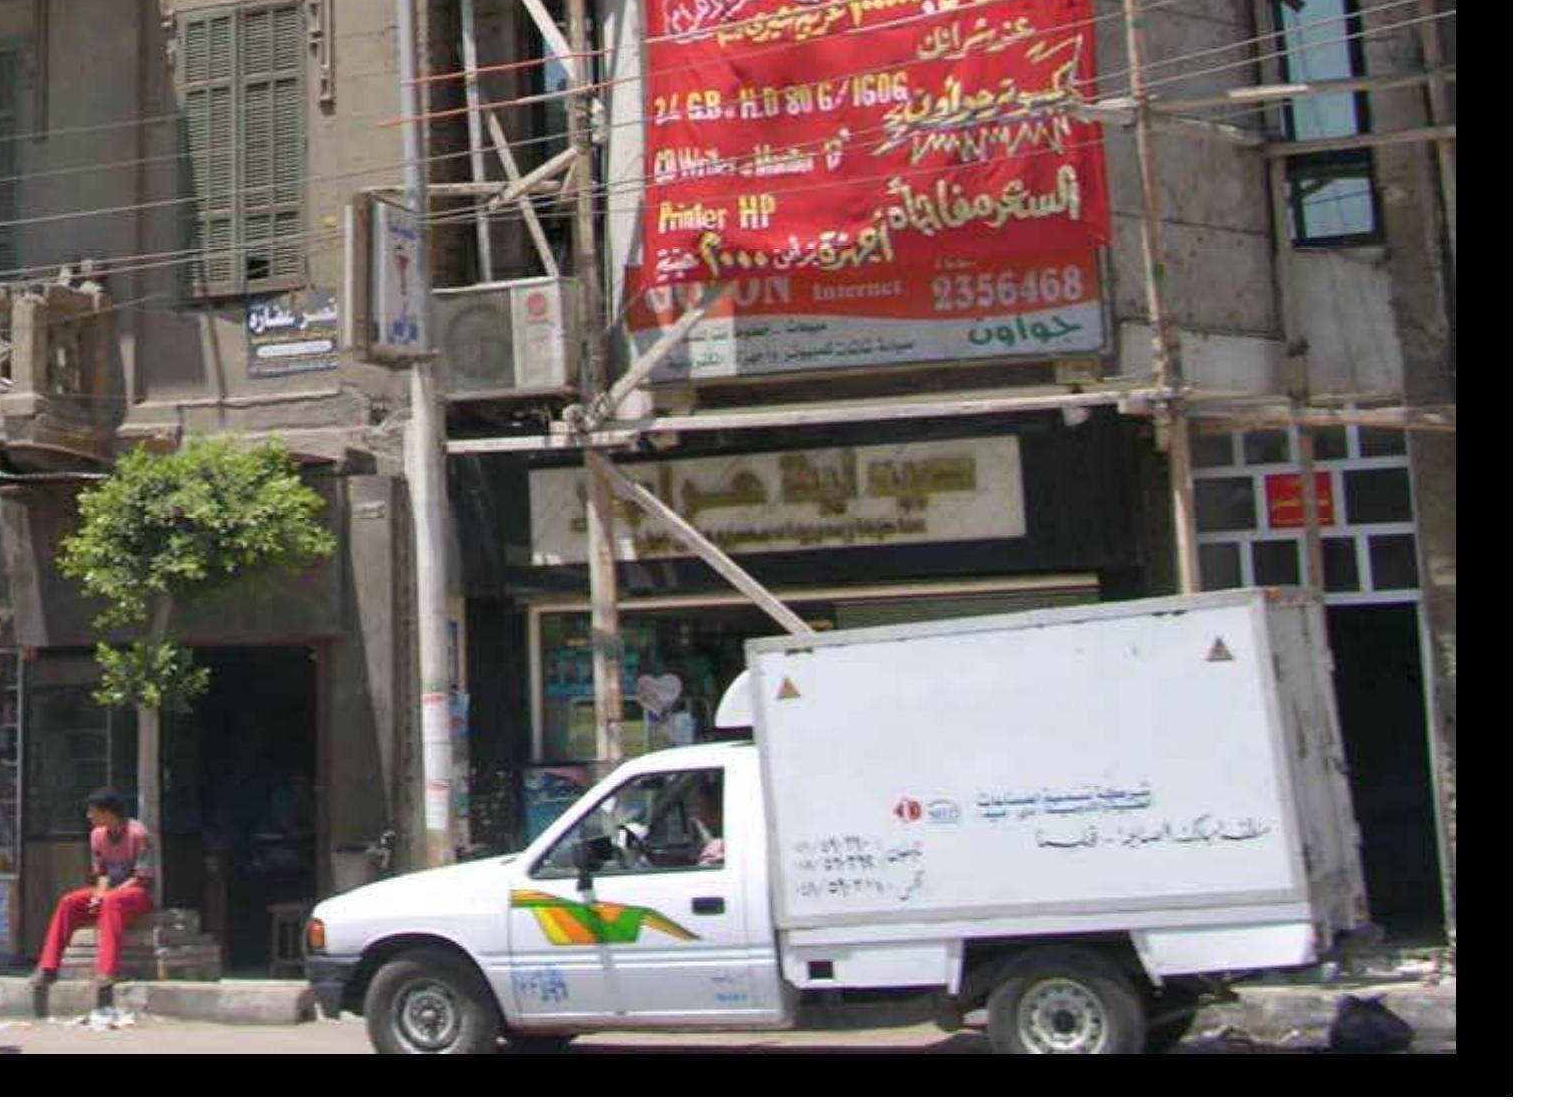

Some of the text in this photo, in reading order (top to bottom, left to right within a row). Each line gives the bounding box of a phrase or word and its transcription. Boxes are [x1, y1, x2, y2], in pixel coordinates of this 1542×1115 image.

[737, 192, 777, 230] HP
[813, 279, 902, 302] Internet
[931, 263, 1083, 312] 2356468
